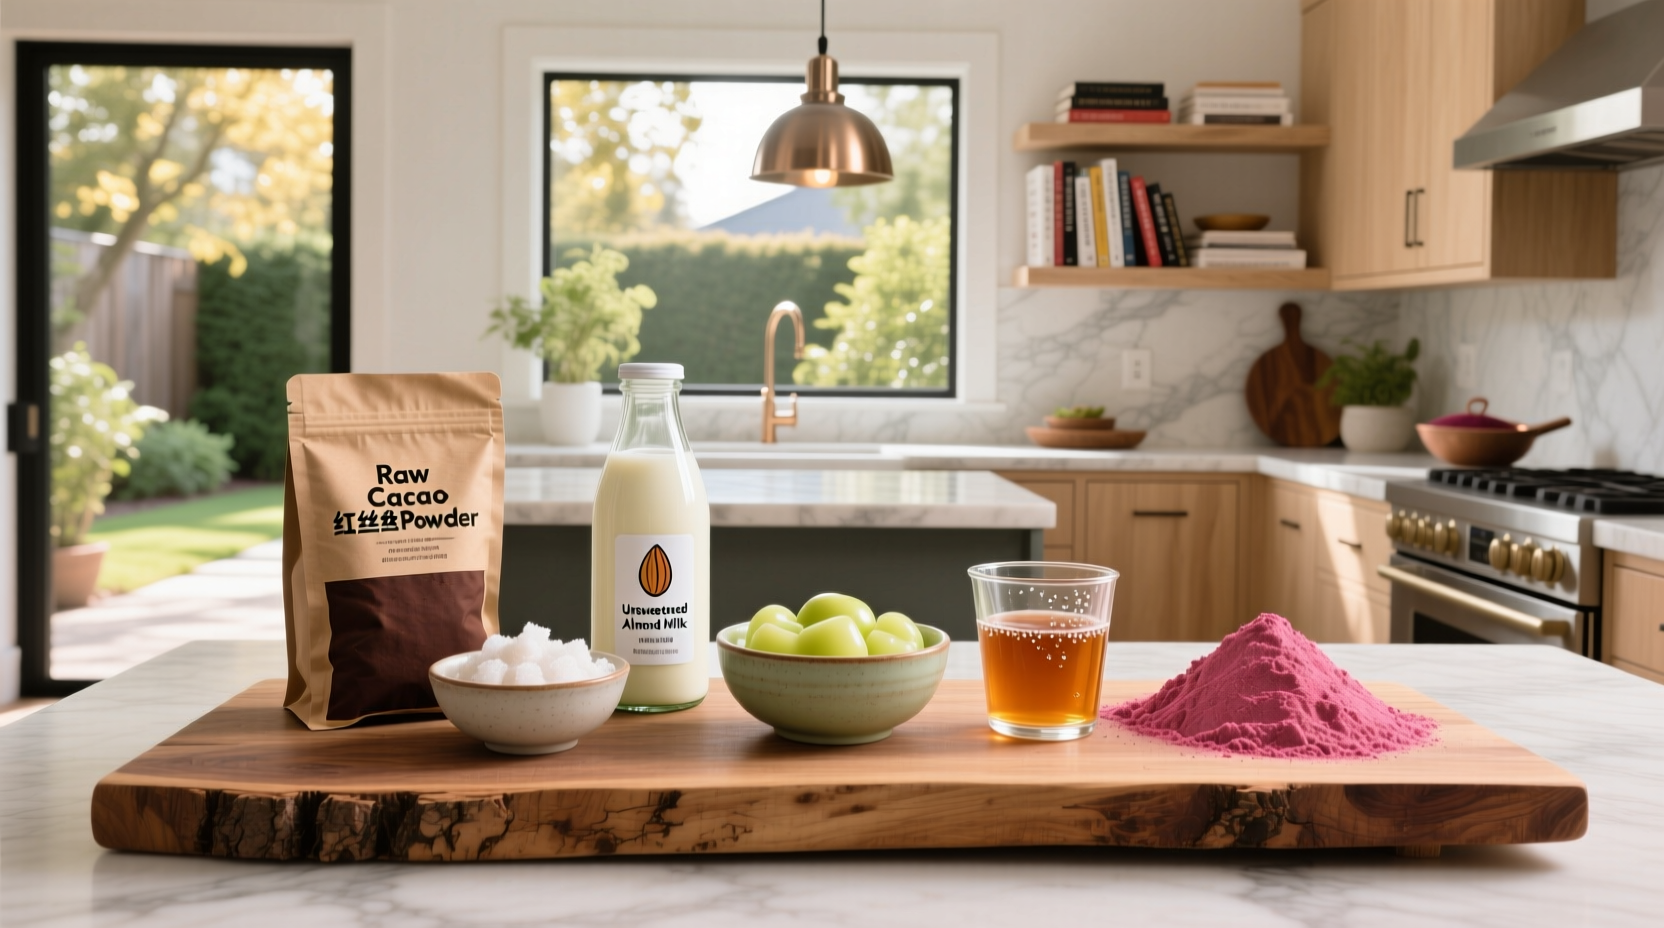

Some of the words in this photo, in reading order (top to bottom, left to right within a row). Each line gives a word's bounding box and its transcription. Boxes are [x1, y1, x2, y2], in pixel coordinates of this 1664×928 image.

[376, 464, 429, 484] Raw
[367, 487, 449, 507] Cacao
[400, 507, 479, 530] Powder
